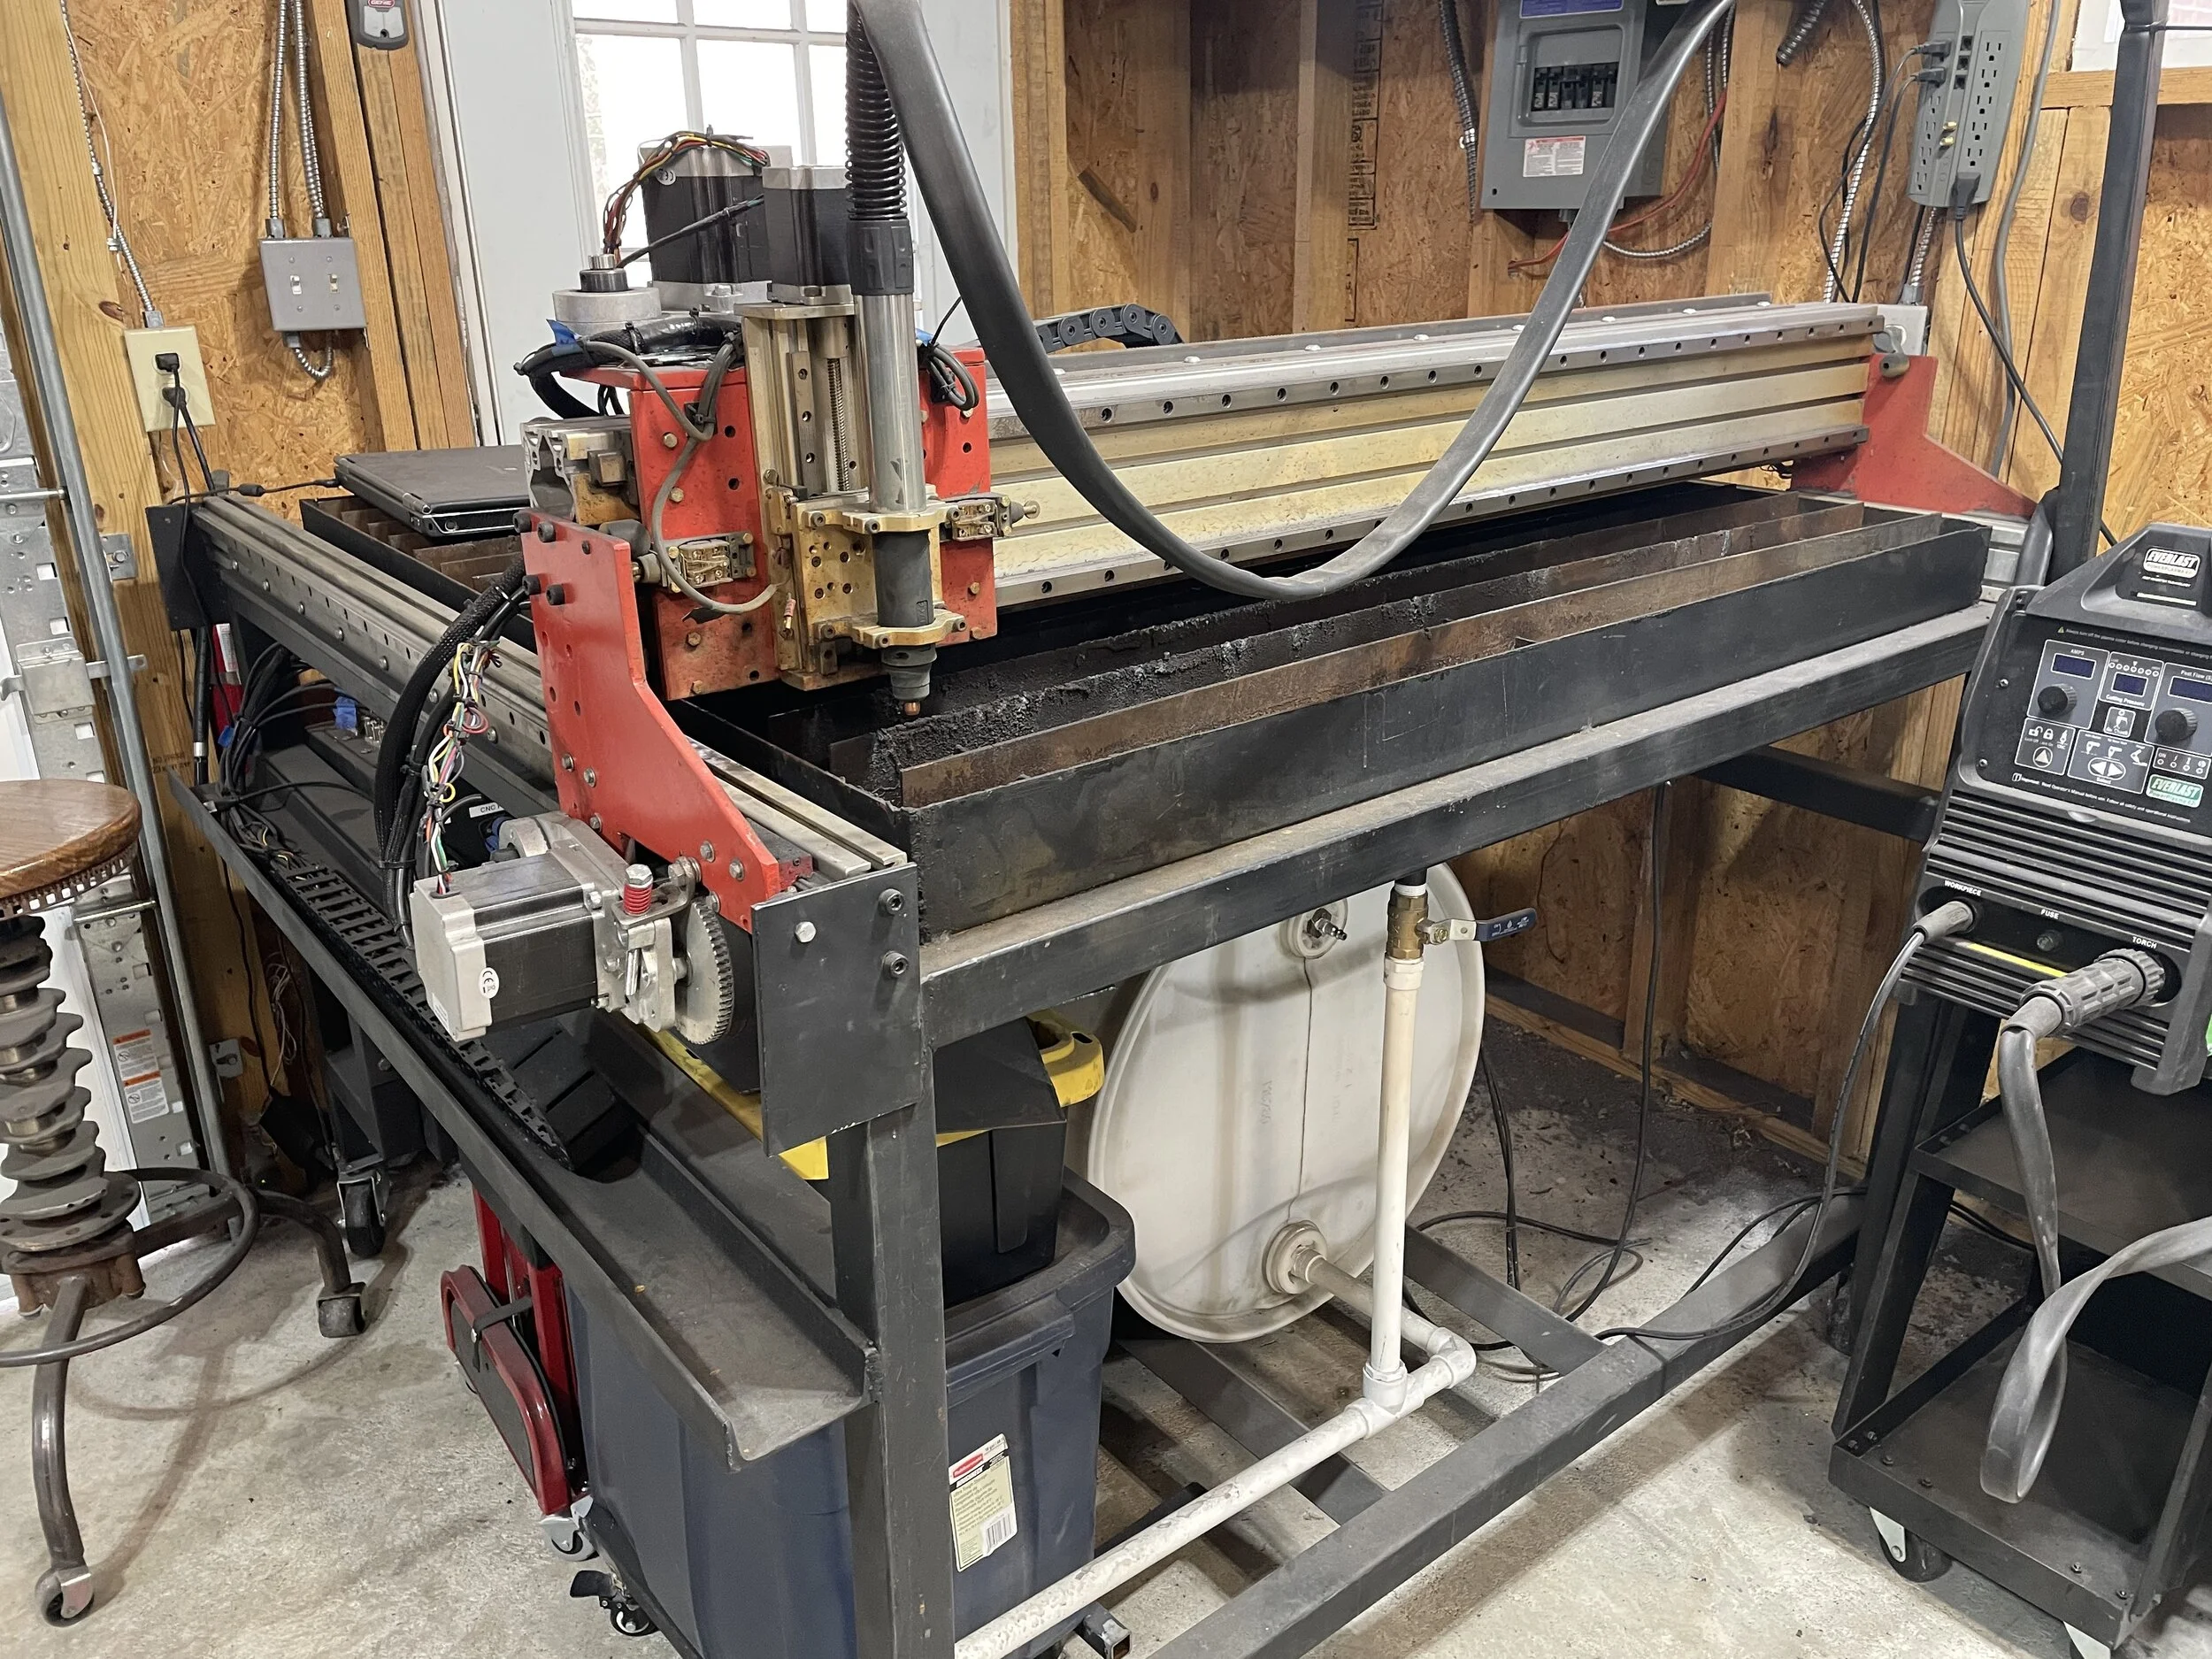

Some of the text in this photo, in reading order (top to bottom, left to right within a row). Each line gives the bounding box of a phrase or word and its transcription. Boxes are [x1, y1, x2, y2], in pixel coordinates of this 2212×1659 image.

[2147, 550, 2198, 568] EVERLAST
[2151, 778, 2201, 798] EVERLAST
[480, 804, 496, 813] CNC
[1944, 879, 1982, 896] WORKPIECE
[2040, 909, 2060, 919] FUSE
[2132, 935, 2158, 949] TORCH
